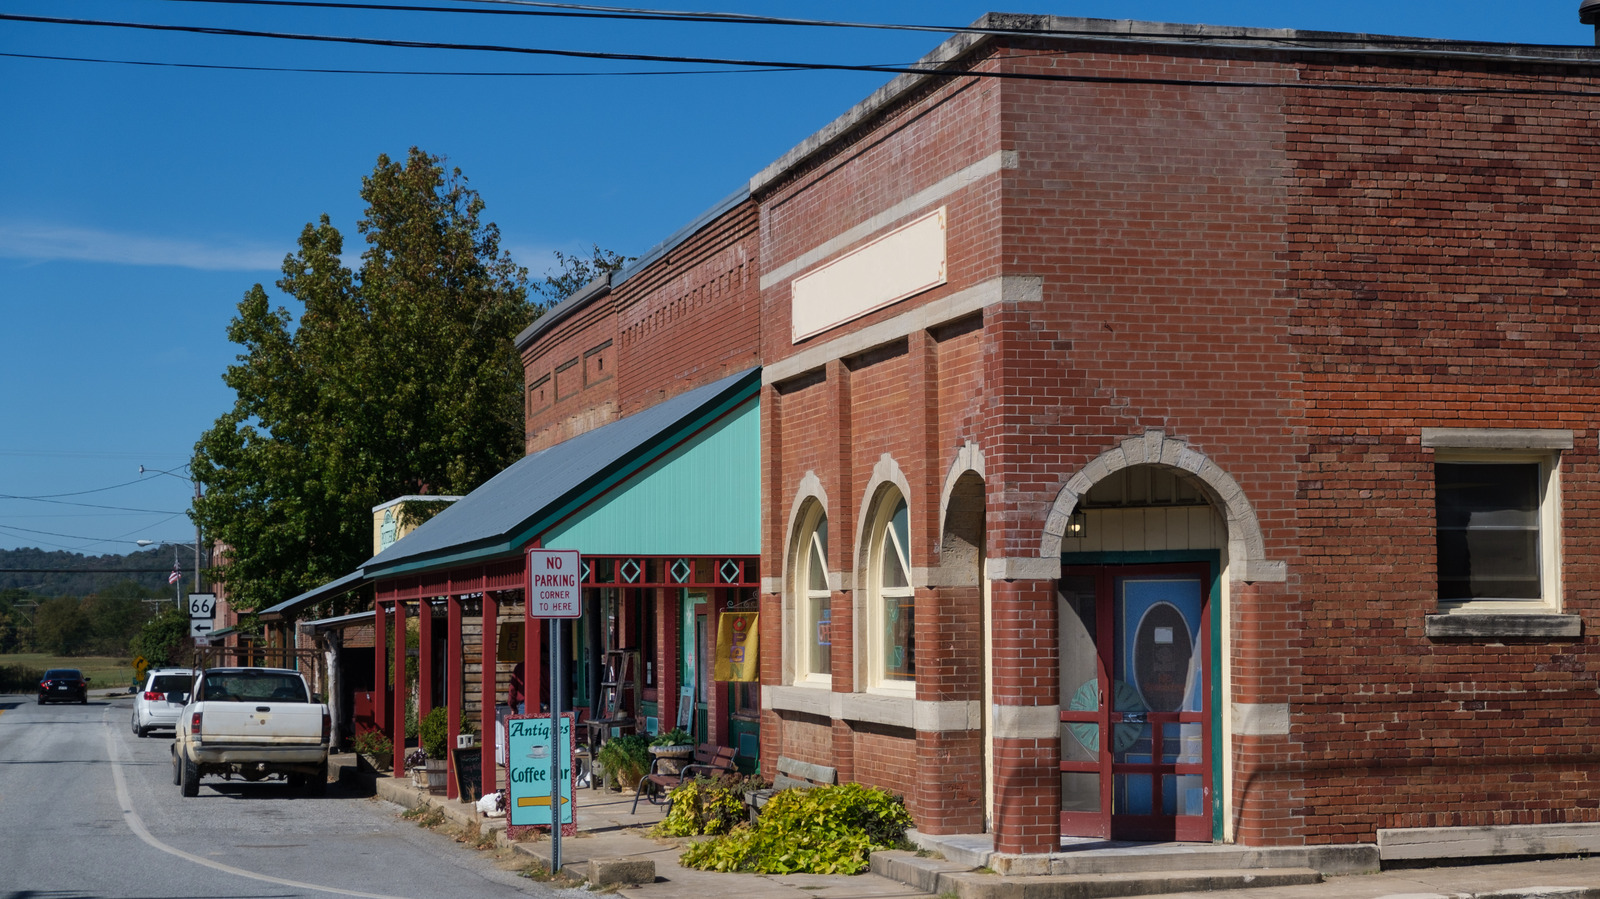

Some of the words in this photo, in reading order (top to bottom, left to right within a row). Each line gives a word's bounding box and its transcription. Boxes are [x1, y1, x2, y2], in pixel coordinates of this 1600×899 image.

[546, 557, 562, 569] NO
[535, 574, 575, 587] PARKING
[540, 591, 570, 599] CORNER
[191, 599, 210, 613] 66
[539, 603, 548, 611] TO
[553, 603, 572, 611] HERE
[510, 722, 570, 740] Antiqes
[511, 766, 546, 783] Coffee
